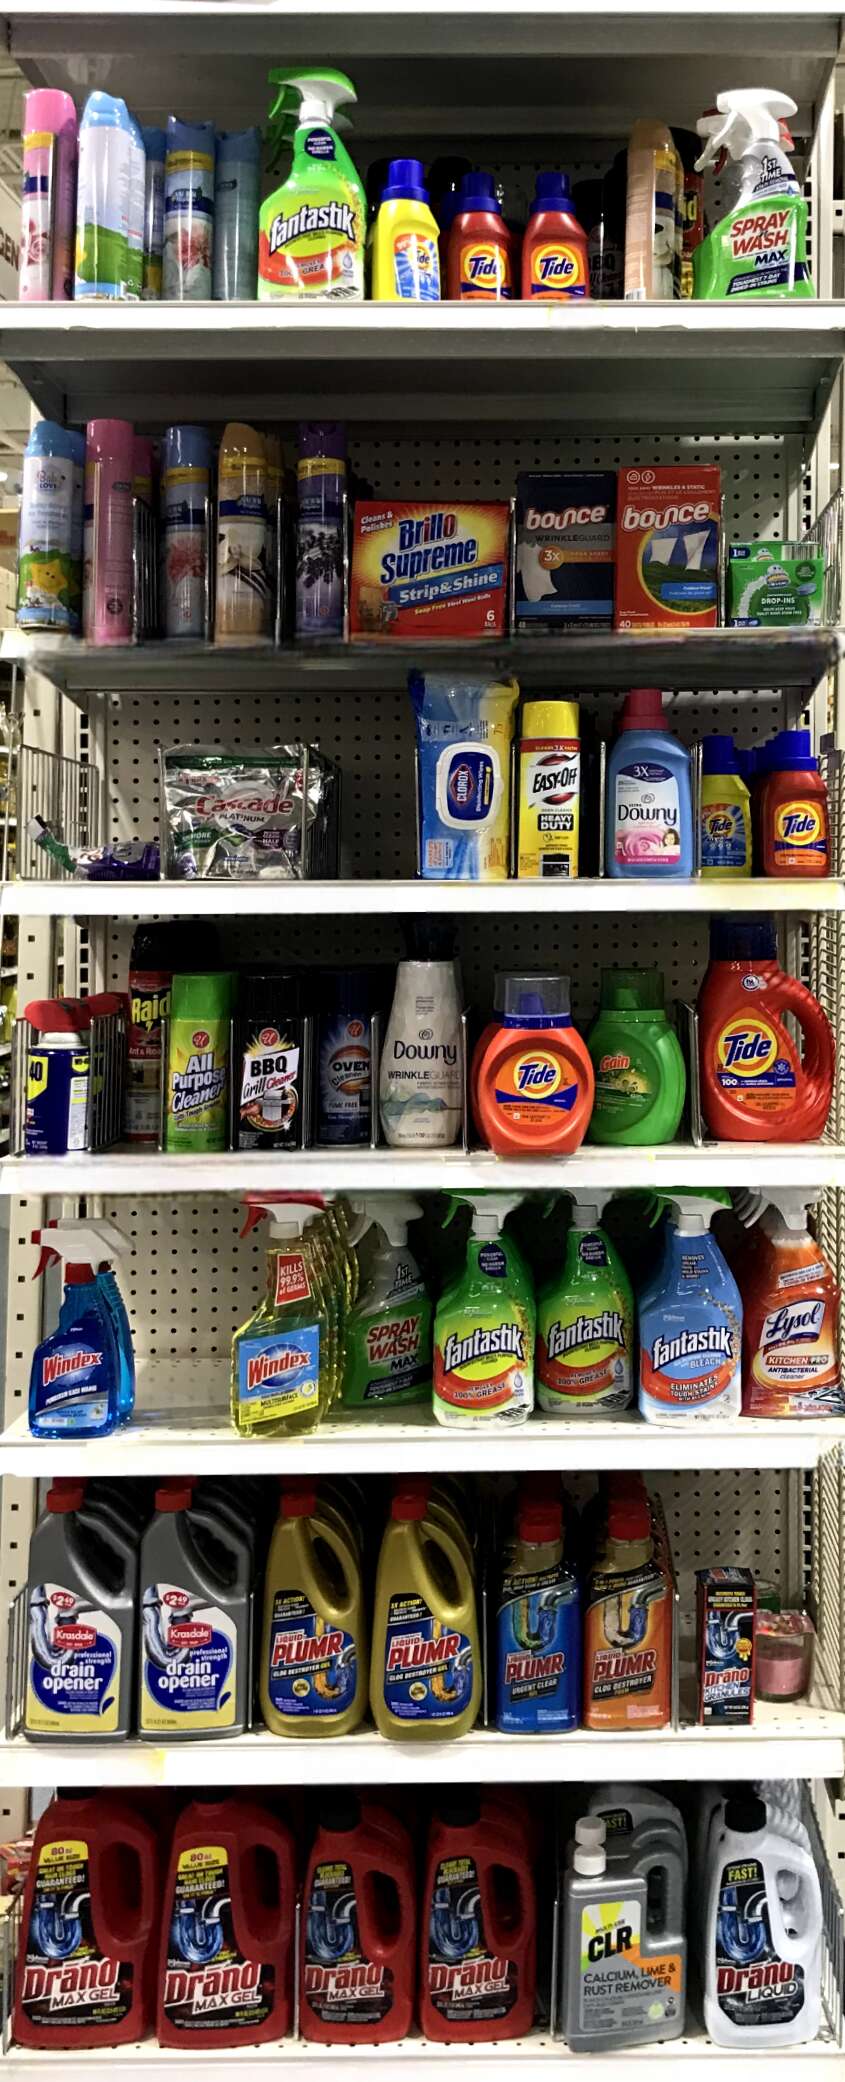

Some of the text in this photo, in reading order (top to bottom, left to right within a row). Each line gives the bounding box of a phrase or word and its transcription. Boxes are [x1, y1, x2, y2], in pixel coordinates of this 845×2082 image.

[760, 167, 781, 181] TIME
[269, 201, 356, 257] fantastik
[731, 211, 790, 237] SPRAY
[733, 230, 788, 257] WASH
[754, 249, 788, 266] MAX
[540, 256, 574, 280] Tide
[361, 511, 393, 525] Cleans &
[526, 505, 607, 530] bounce
[623, 502, 711, 531] bounce
[361, 520, 393, 534] Polishes
[399, 513, 457, 551] Brillo
[380, 538, 478, 584] Supreme
[399, 573, 498, 604] Strip&Shine
[761, 597, 796, 605] DROP-INS
[486, 609, 495, 622] 6
[619, 620, 631, 629] 40
[533, 767, 578, 794] EASY-OFF
[633, 766, 649, 777] 3X
[456, 770, 469, 802] CLOROX
[195, 793, 295, 818] Cascade
[618, 804, 677, 827] Downy
[540, 822, 572, 830] DUTY
[709, 818, 733, 835] Tide
[782, 814, 816, 838] Tide
[393, 1040, 457, 1066] Downy
[724, 1032, 772, 1067] Tide
[187, 1053, 214, 1075] All
[250, 1055, 288, 1078] BBQ
[601, 1055, 630, 1072] Gain
[172, 1068, 226, 1091] Purpose
[243, 1072, 296, 1100] Grill Cleaner
[518, 1062, 556, 1091] Tide
[721, 1078, 738, 1086] 100
[171, 1082, 225, 1113] Cleaner
[280, 1261, 303, 1276] KILLS
[280, 1272, 305, 1287] 99.9%
[367, 1315, 420, 1344] SPRAY
[766, 1302, 821, 1339] Lysol
[547, 1311, 626, 1361] fantastik
[370, 1334, 419, 1361] WASH
[443, 1323, 526, 1377] fantastik
[653, 1326, 733, 1373] fantastik
[43, 1351, 103, 1386] Windex
[390, 1354, 418, 1371] MAX
[689, 1360, 721, 1369] BLEACH
[768, 1356, 809, 1365] KITCHEN
[247, 1350, 312, 1391] Windex
[579, 1368, 608, 1385] GREASE
[477, 1382, 507, 1398] GREASE
[671, 1376, 721, 1391] ELIMINATES
[55, 1629, 94, 1641] Krasdale
[170, 1626, 209, 1639] Krasdale
[392, 1637, 421, 1647] LIQUID
[74, 1651, 112, 1659] professional
[190, 1646, 228, 1657] professional
[201, 1653, 228, 1662] strength
[271, 1632, 344, 1667] PLUMR
[387, 1635, 460, 1671] PLUMR
[51, 1661, 95, 1678] drain
[85, 1658, 112, 1666] strength
[166, 1659, 212, 1676] drain
[505, 1652, 564, 1684] PLUMR
[593, 1650, 656, 1683] PLUMR
[42, 1677, 104, 1695] opener
[158, 1673, 220, 1694] opener
[512, 1679, 558, 1695] URGENT CLEAR
[594, 1676, 652, 1694] CLOG DESTROYER
[604, 1815, 627, 1829] AST!
[51, 1847, 65, 1856] 80
[190, 1853, 204, 1862] 80
[36, 1874, 85, 1889] GUARANTEED!
[728, 1867, 758, 1882] FAST!
[175, 1880, 225, 1895] GUARANTEED!
[588, 1926, 633, 1963] CLR
[583, 1962, 676, 1984] CALCIUM, LIME &
[328, 1985, 384, 2000] MAX GEL
[453, 1981, 509, 2000] MAX GEL
[584, 1976, 672, 1997] RUST REMOVER
[748, 1985, 797, 2002] LIQUID
[52, 1988, 118, 2009] MAX GEL
[194, 1990, 261, 2012] MAX GEL
